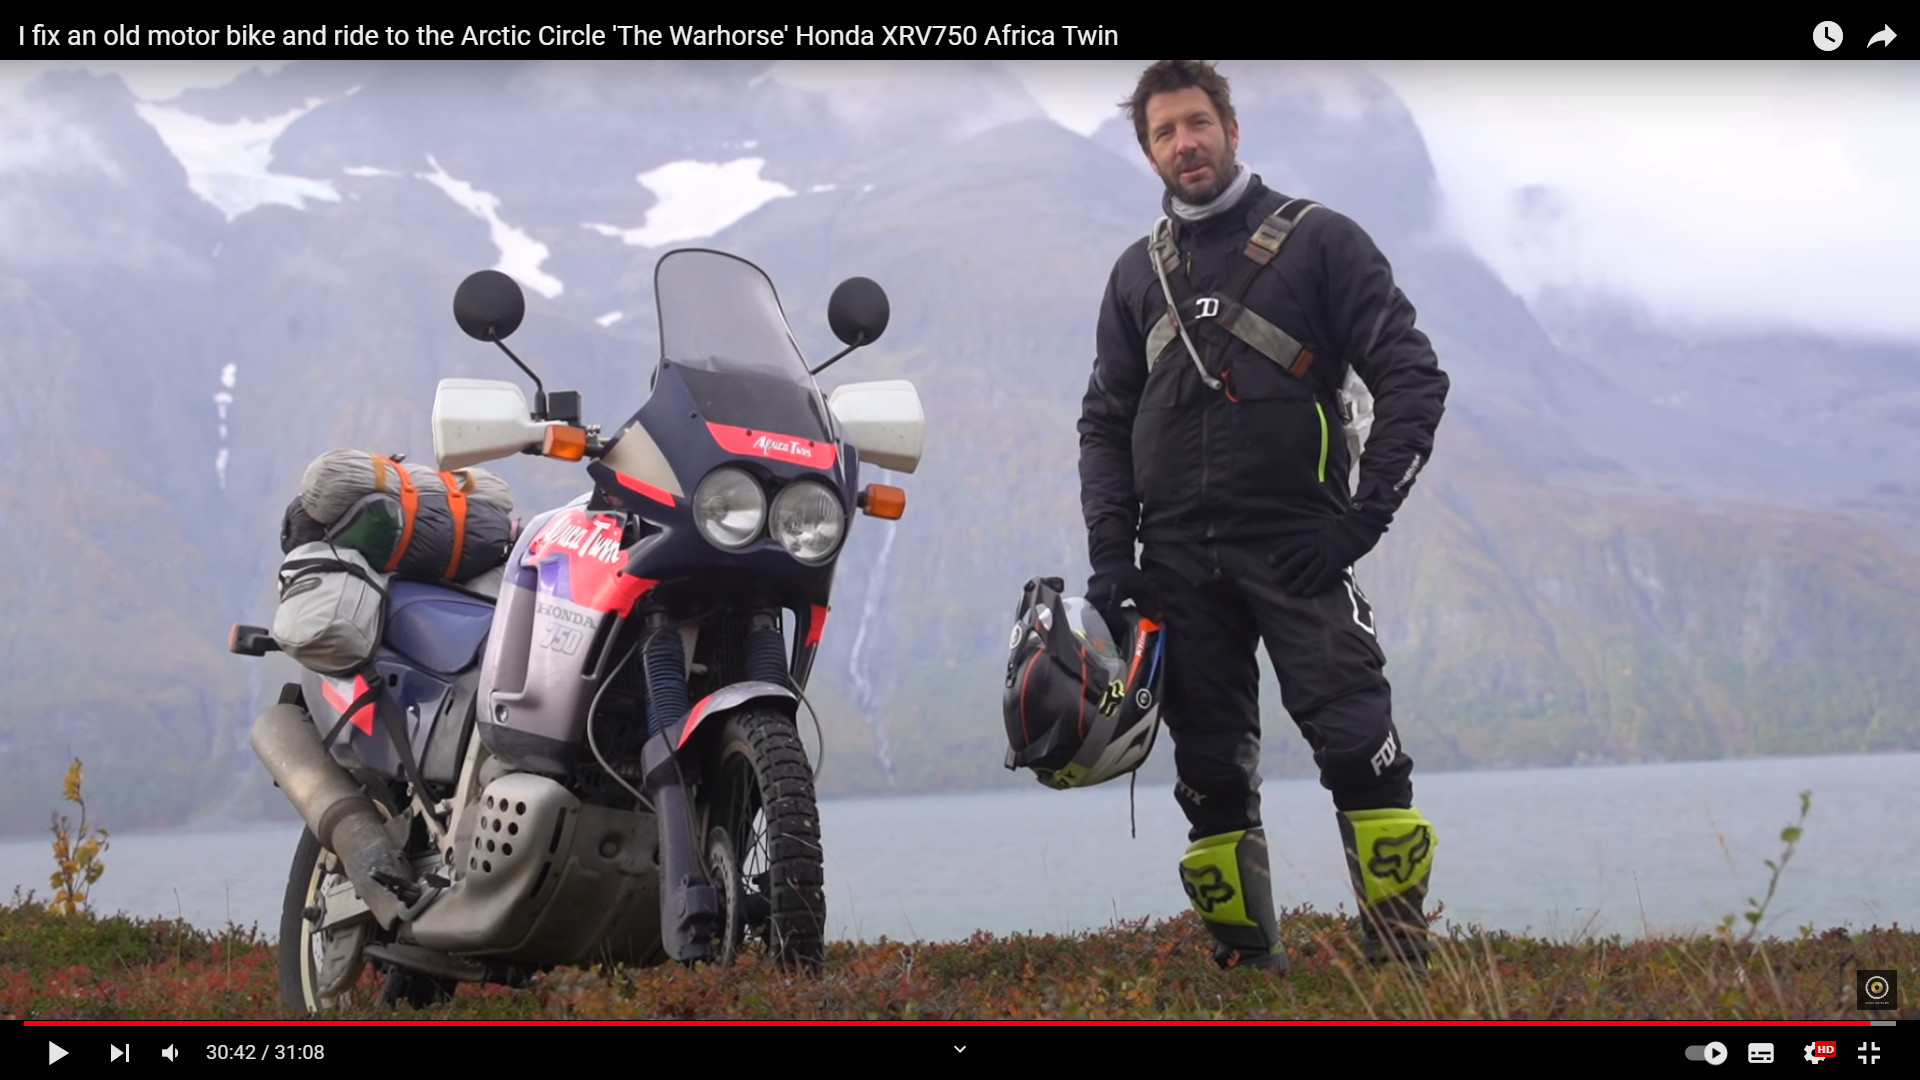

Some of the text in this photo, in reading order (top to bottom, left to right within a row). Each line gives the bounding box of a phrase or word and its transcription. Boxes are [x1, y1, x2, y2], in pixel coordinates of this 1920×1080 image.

[577, 520, 620, 564] Twin
[536, 602, 597, 629] HONDA
[540, 623, 584, 656] 750
[1370, 730, 1397, 777] FOX
